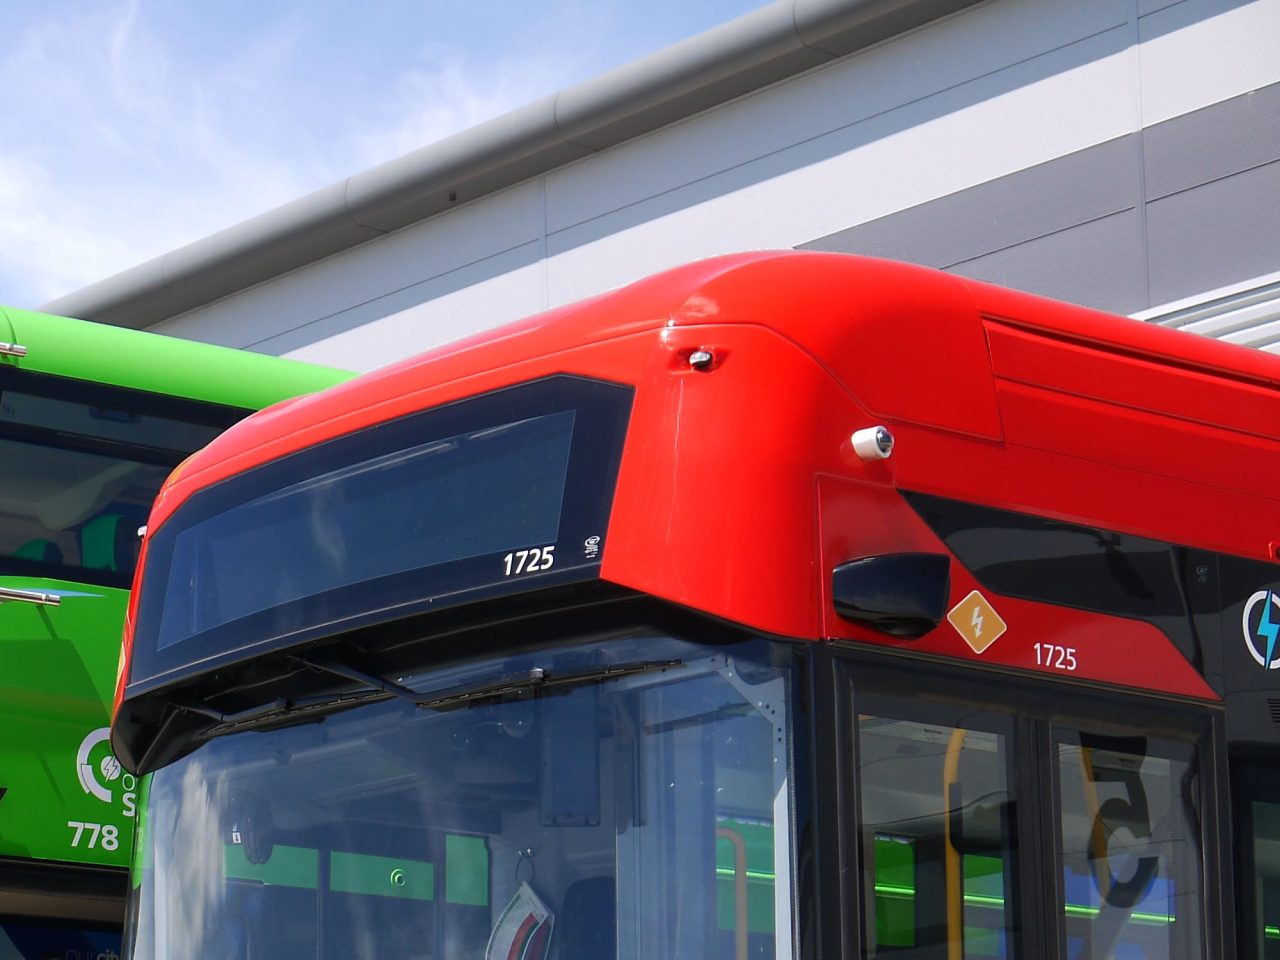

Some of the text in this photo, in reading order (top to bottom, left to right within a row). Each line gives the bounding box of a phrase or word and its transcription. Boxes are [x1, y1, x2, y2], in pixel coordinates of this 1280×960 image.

[504, 546, 555, 576] 1725
[1034, 642, 1076, 670] 1725
[68, 821, 119, 851] 778
